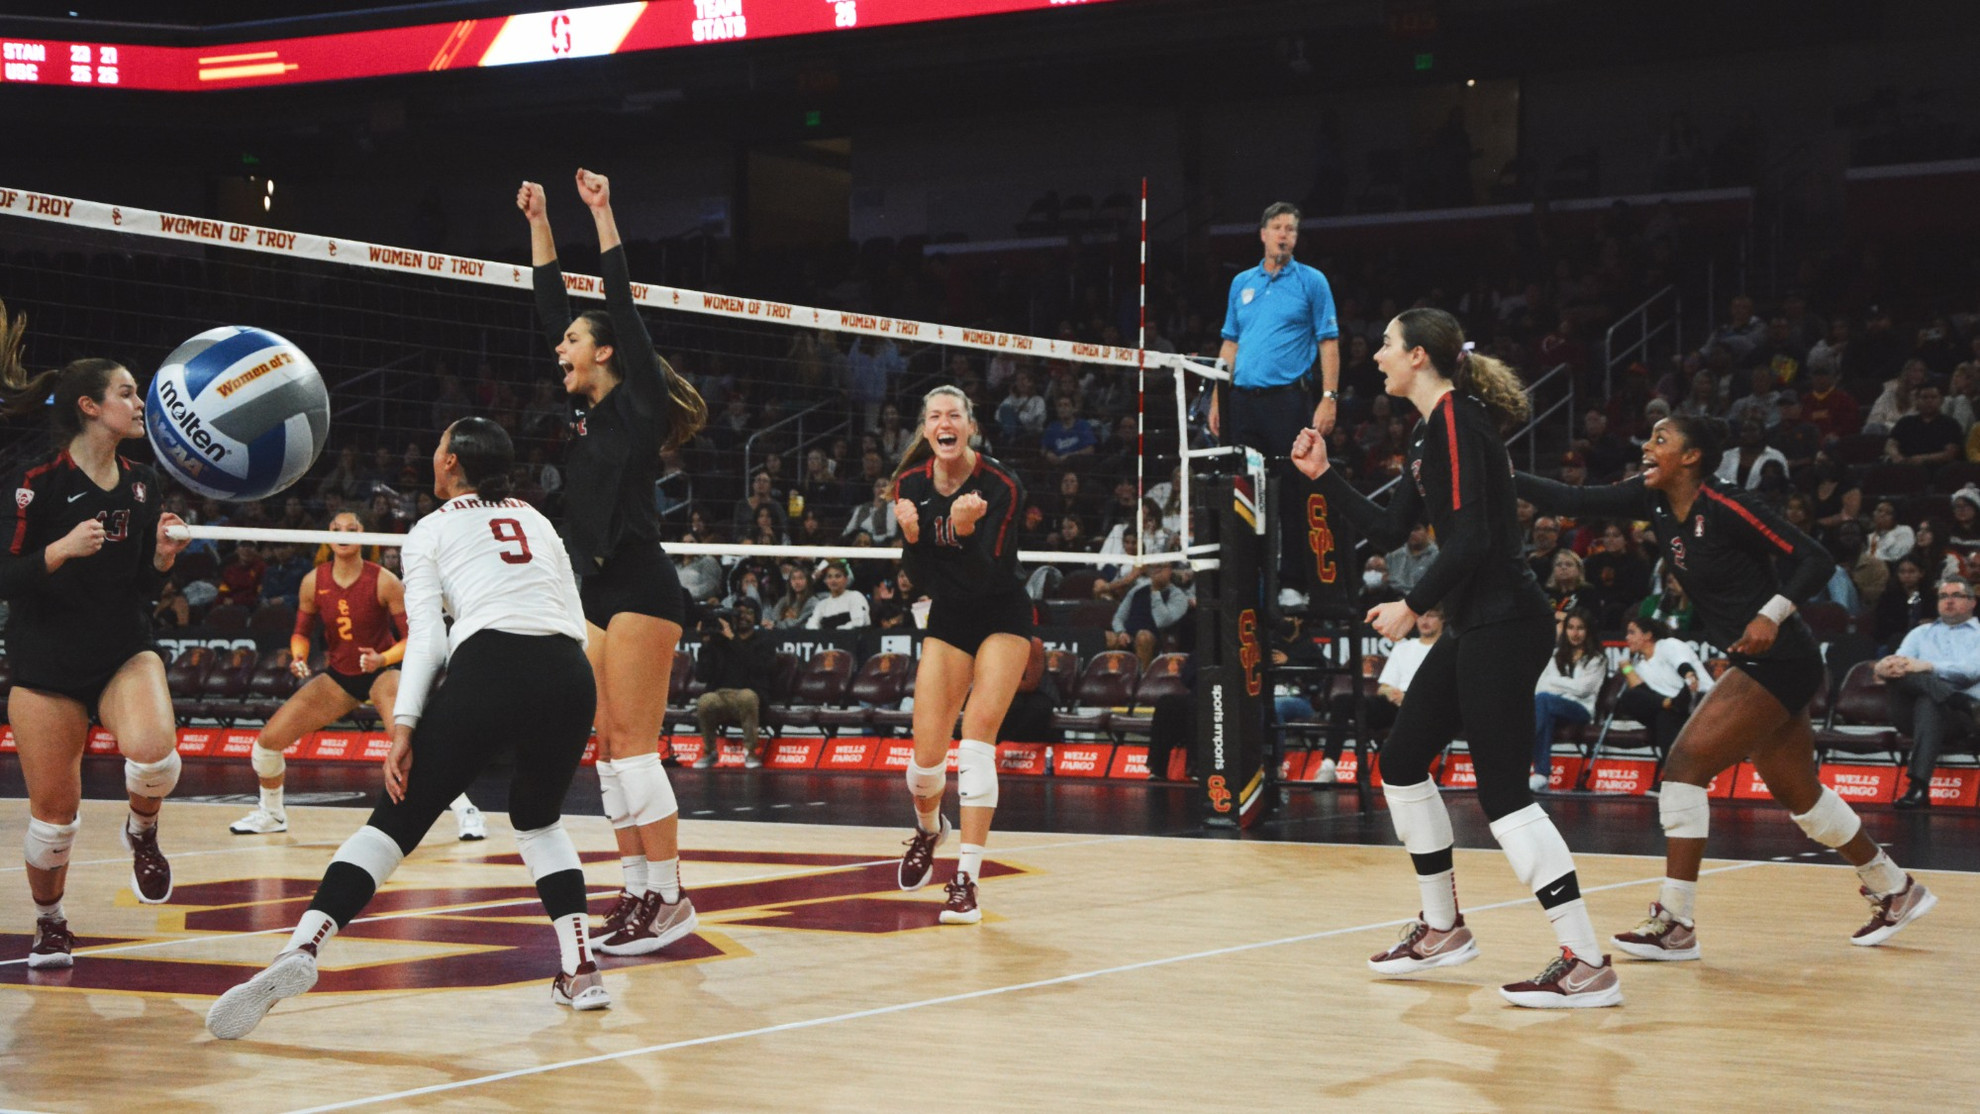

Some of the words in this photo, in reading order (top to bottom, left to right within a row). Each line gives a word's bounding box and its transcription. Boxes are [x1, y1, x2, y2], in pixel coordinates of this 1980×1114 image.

[693, 0, 742, 19] TEAM
[692, 15, 747, 42] STATS
[3, 42, 46, 62] STAN
[5, 62, 38, 81] USC
[26, 194, 73, 218] TROY
[160, 214, 224, 240] WOMEN
[229, 225, 250, 243] OF
[256, 230, 296, 250] TROY
[369, 246, 422, 269] WOMEN
[427, 256, 445, 272] OF
[450, 259, 485, 278] TROY
[703, 294, 744, 313] WOMEN
[748, 301, 760, 314] OF
[765, 304, 792, 320] TROY
[840, 312, 877, 331] WOMEN
[880, 318, 893, 332] OF
[896, 320, 919, 337] TROY
[962, 329, 995, 346] WOMEN
[997, 333, 1009, 347] OF
[1012, 335, 1033, 350] TROY
[216, 362, 271, 399] Women
[268, 354, 284, 370] of
[160, 380, 228, 463] molten
[151, 410, 208, 478] NCAA
[488, 518, 533, 565] 9
[336, 616, 353, 641] 2
[1211, 684, 1224, 723] sports
[317, 747, 345, 756] FARGO
[321, 738, 348, 748] WELLS
[779, 745, 810, 755] WELLS
[835, 745, 867, 754] WELLS
[1211, 723, 1225, 771] imports
[774, 754, 808, 764] FARGO
[831, 754, 863, 763] FARGO
[1001, 759, 1034, 769] FARGO
[1004, 749, 1036, 760] WELLS
[1064, 751, 1098, 761] WELLS
[1060, 761, 1095, 771] FARGO
[1597, 768, 1639, 780] WELLS
[1595, 779, 1637, 791] FARGO
[1834, 773, 1880, 785] WELLS
[1929, 777, 1962, 788] ELLS
[1833, 784, 1878, 797] FARGO
